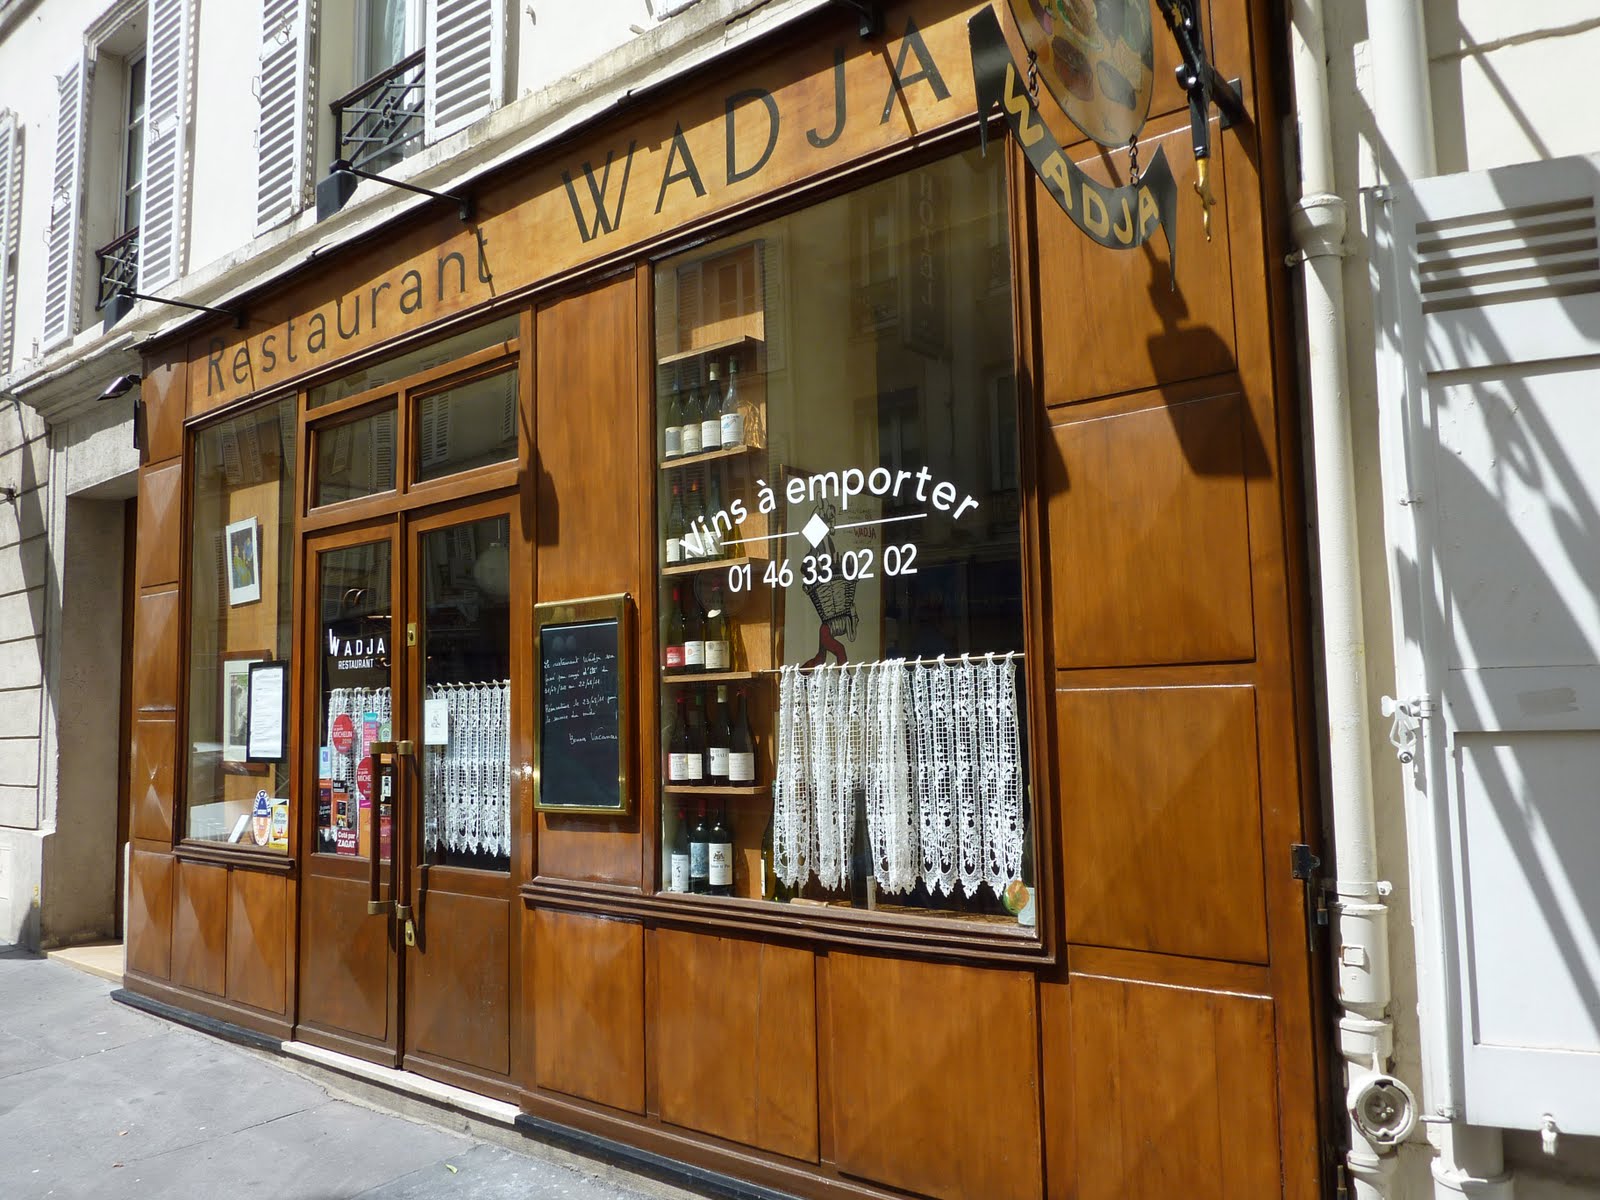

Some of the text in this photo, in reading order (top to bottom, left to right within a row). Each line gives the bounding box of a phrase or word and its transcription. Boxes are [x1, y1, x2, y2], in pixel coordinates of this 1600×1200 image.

[1003, 62, 1160, 245] WADJA
[206, 15, 951, 398] Restaurant WADJA
[679, 465, 980, 558] Vins à emporter
[728, 543, 918, 593] 01 46 33 02 02
[328, 628, 386, 657] WADJA
[338, 658, 374, 670] RESTAURANT
[337, 839, 356, 848] ZAGAT
